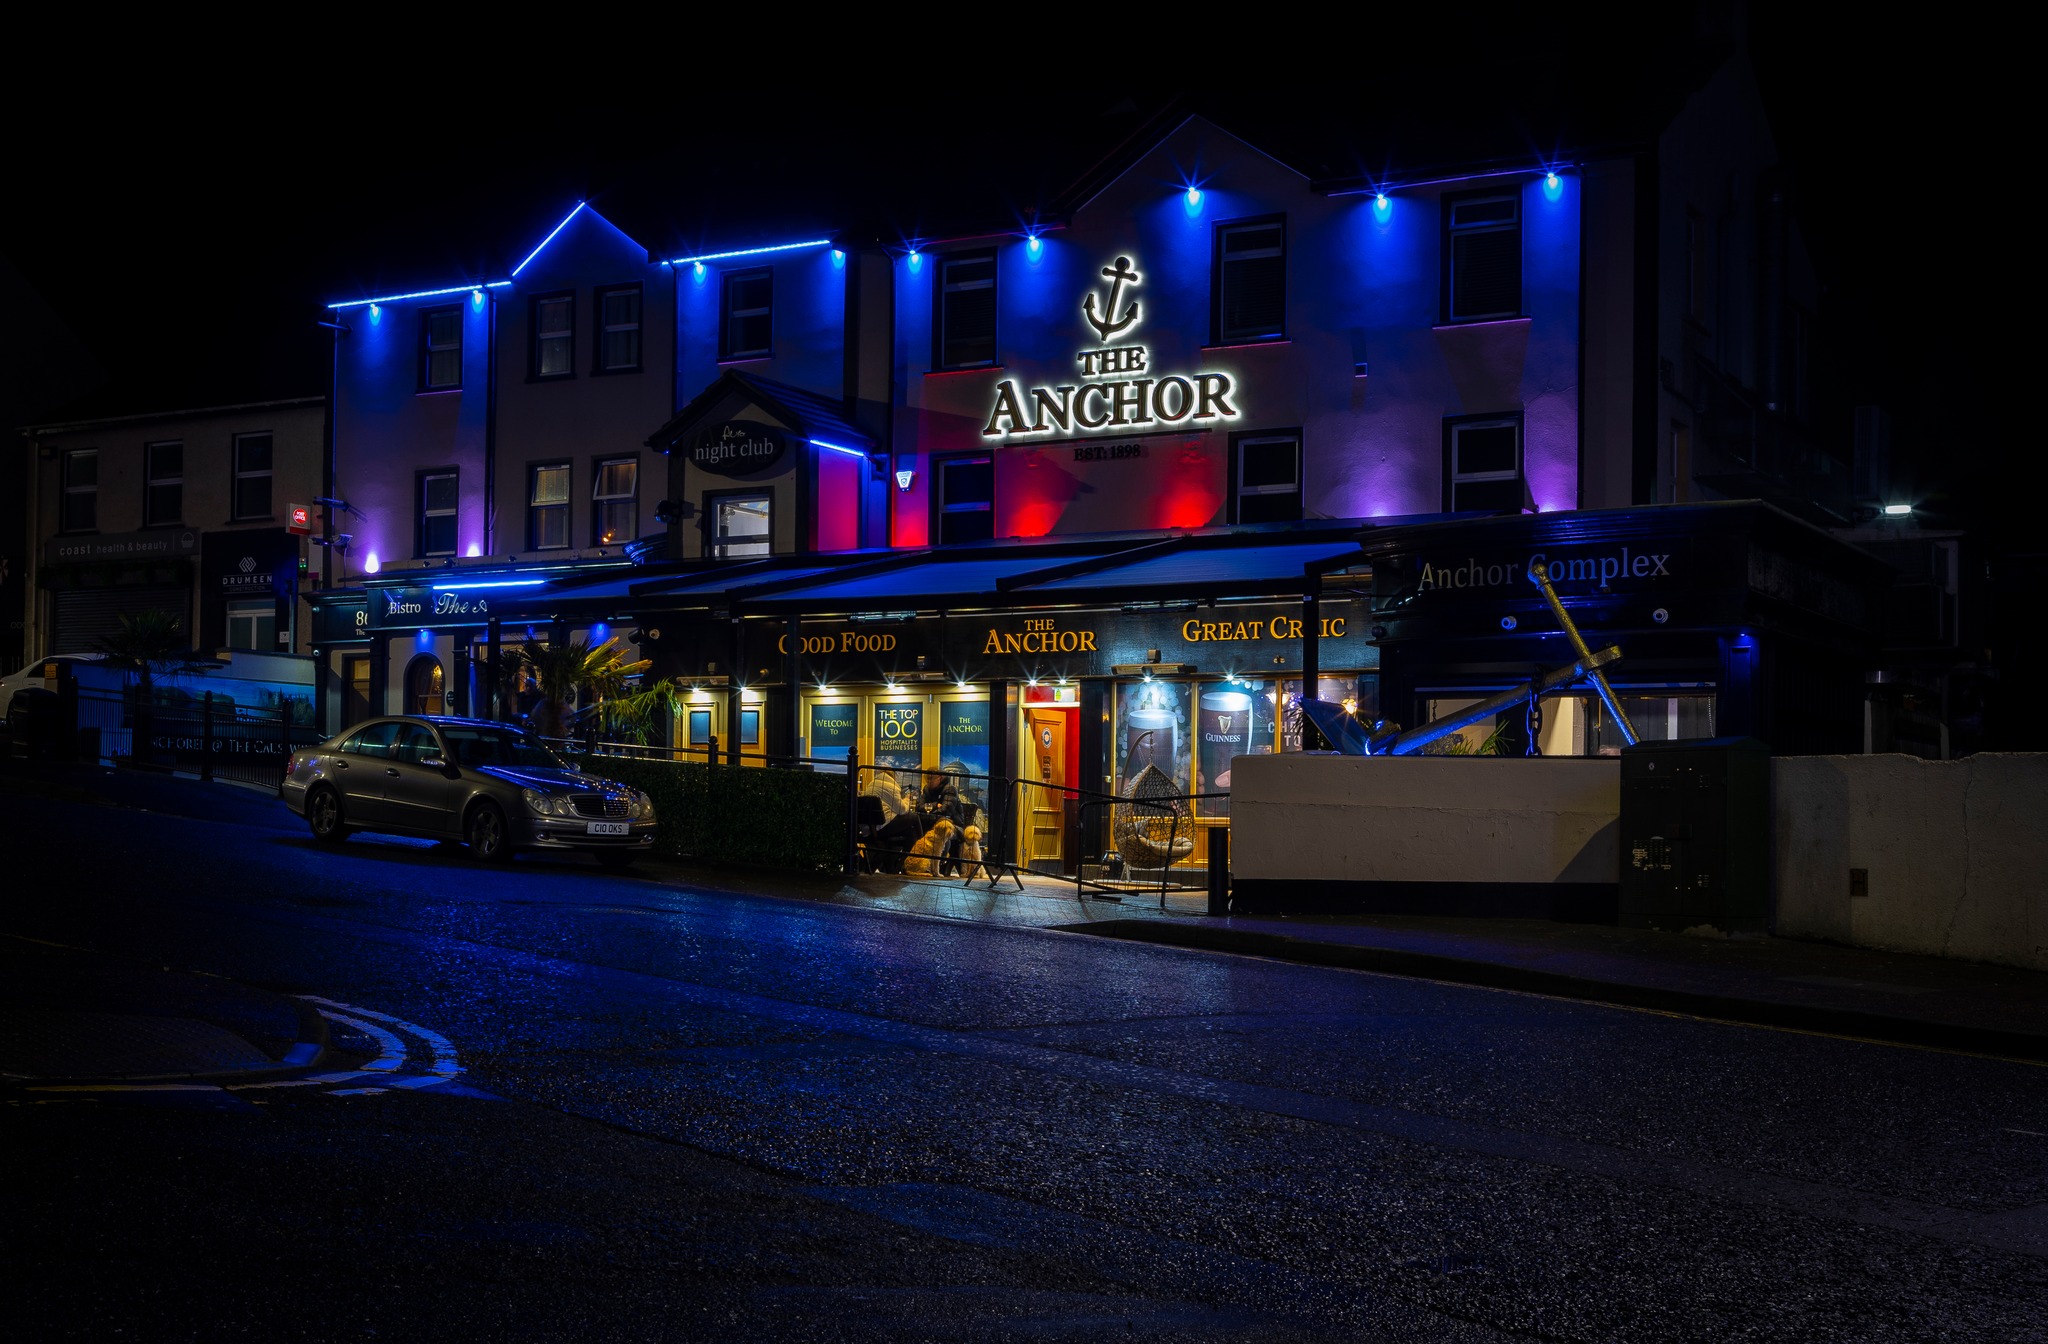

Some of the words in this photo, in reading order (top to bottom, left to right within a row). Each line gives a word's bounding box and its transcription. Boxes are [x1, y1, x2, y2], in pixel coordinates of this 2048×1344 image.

[1077, 346, 1146, 376] THE
[983, 373, 1236, 436] ANCHOR
[695, 441, 736, 463] night
[740, 437, 774, 457] club
[1110, 444, 1141, 459] 1898
[59, 544, 91, 556] coast
[96, 543, 125, 554] health
[128, 542, 133, 552] &
[136, 541, 168, 551] beauty
[222, 575, 273, 585] DRUMEEN
[1417, 557, 1519, 592] Anchor
[389, 601, 422, 615] Bistro
[434, 592, 469, 614] The
[1023, 618, 1055, 632] THE
[1181, 619, 1264, 642] GREAT
[1269, 615, 1347, 640] CRIC
[840, 631, 897, 653] FOOD
[982, 628, 1098, 655] ANCHOR
[815, 719, 854, 728] WELCOME
[878, 709, 897, 720] THE
[899, 709, 918, 720] TOP
[880, 720, 918, 739] 100
[947, 725, 983, 733] ANCHOR
[1205, 733, 1241, 743] GUINNESS
